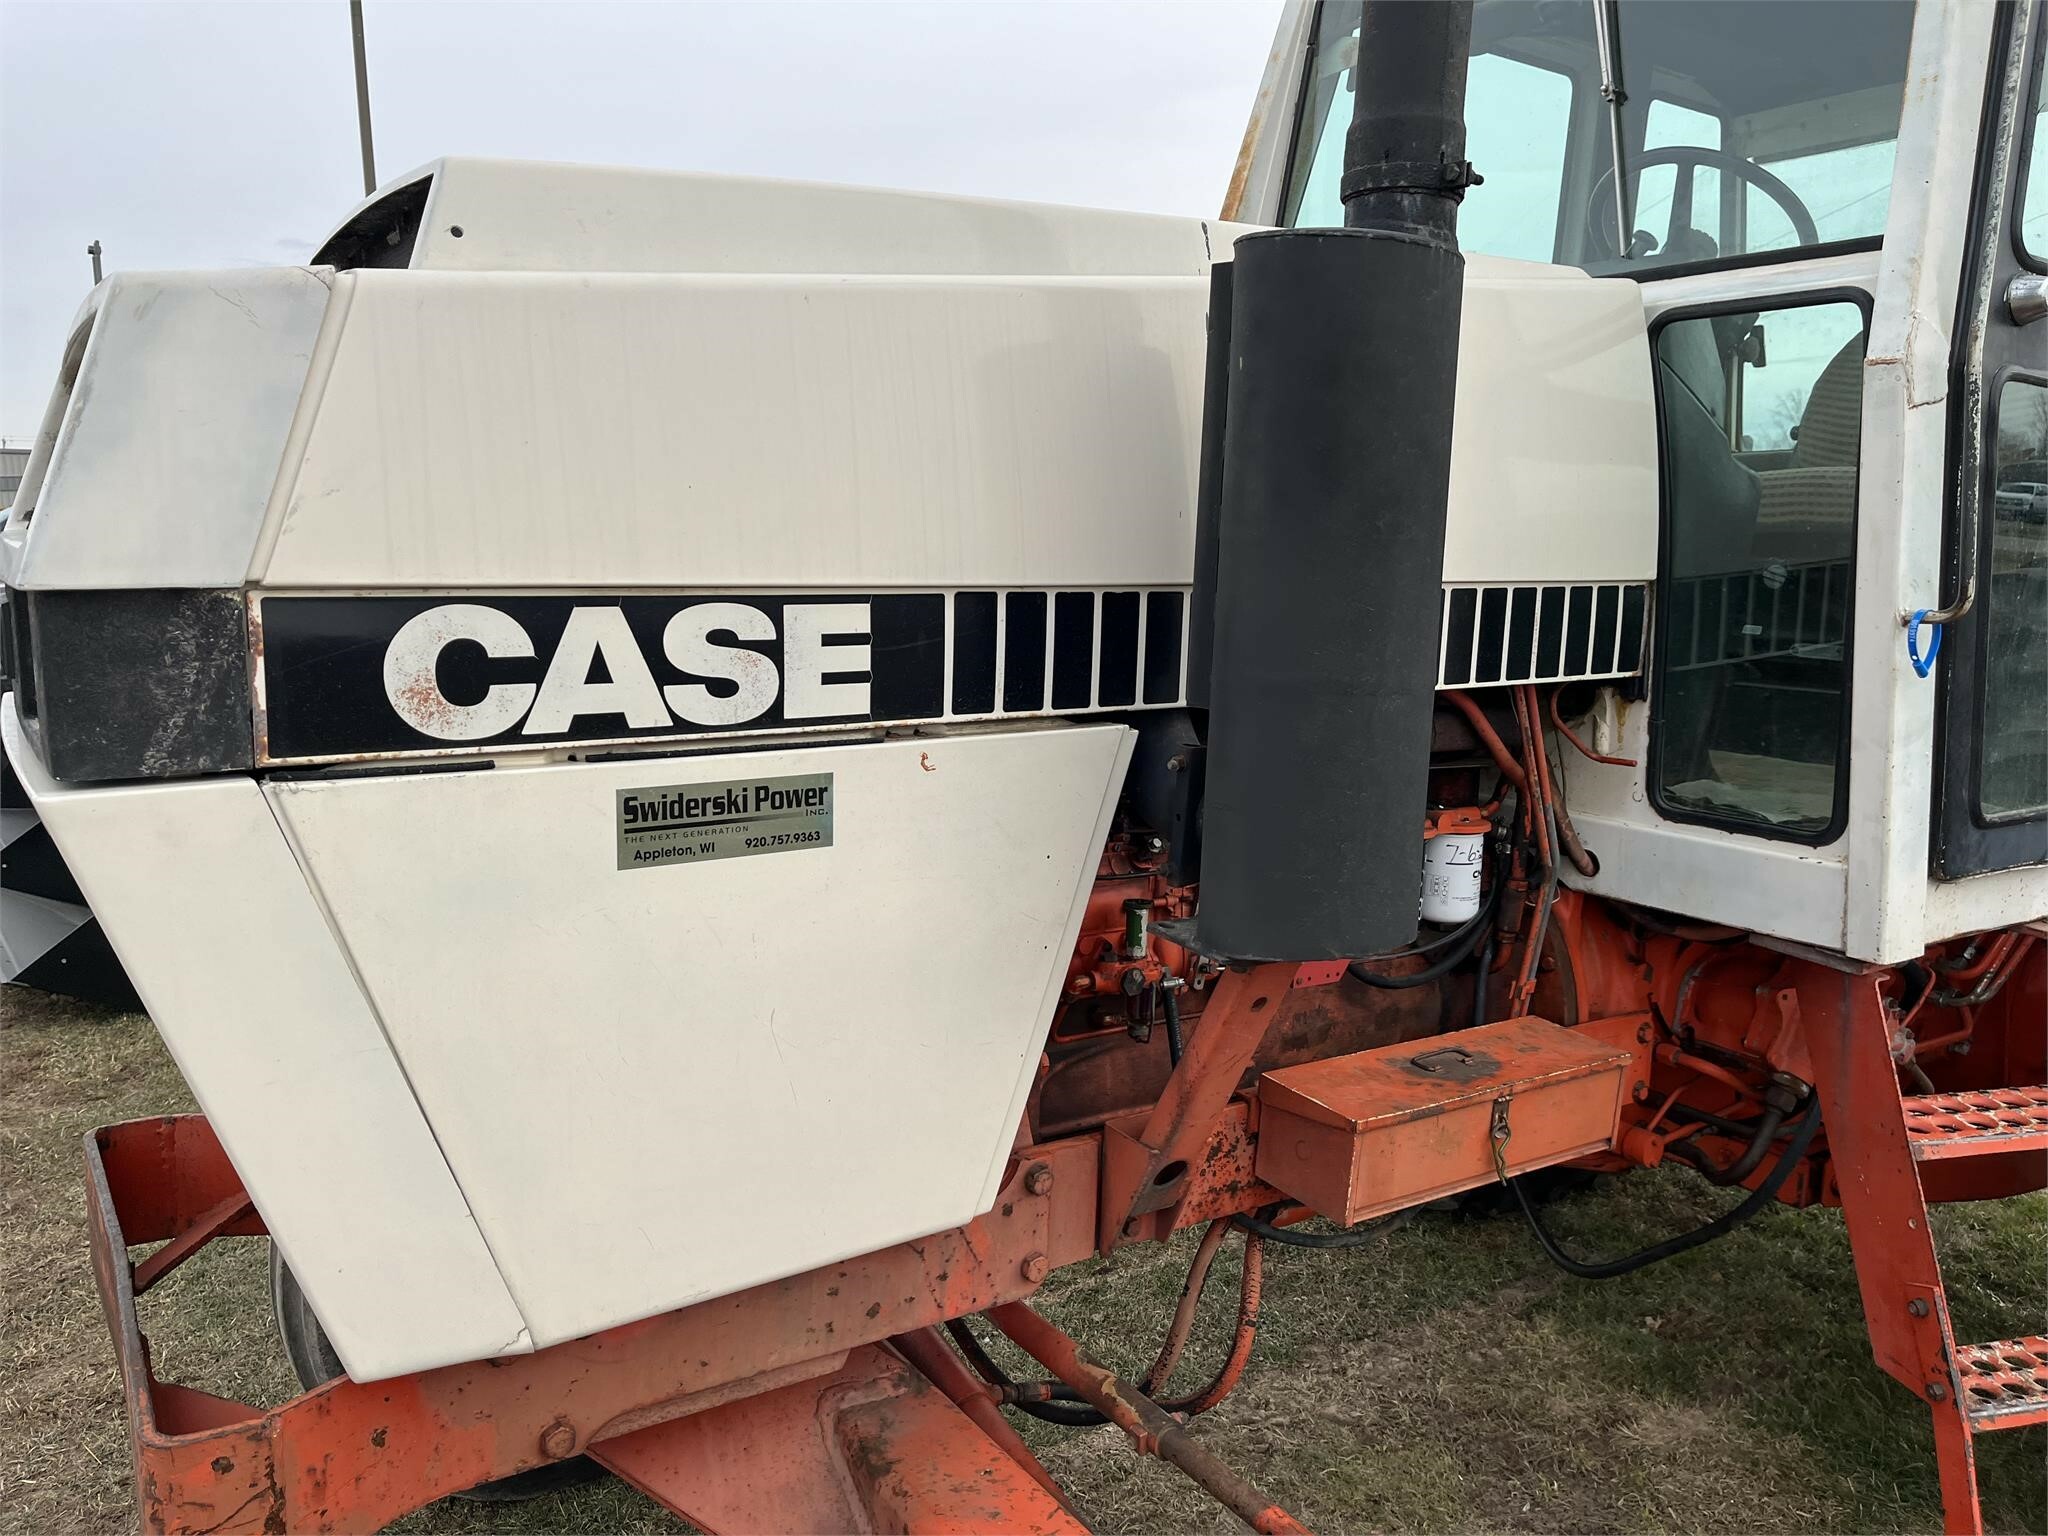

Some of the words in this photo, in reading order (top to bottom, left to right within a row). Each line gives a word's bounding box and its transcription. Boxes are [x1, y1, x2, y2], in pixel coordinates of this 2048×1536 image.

[383, 602, 872, 740] CASE
[623, 787, 748, 824] Swiderski
[754, 785, 829, 812] Power
[805, 808, 829, 817] INC.
[624, 835, 646, 844] THE
[650, 832, 678, 842] NEXT
[683, 825, 749, 838] GENERATION
[633, 845, 696, 863] Appleton,
[700, 842, 715, 853] WI
[745, 831, 821, 849] 920.757.9363
